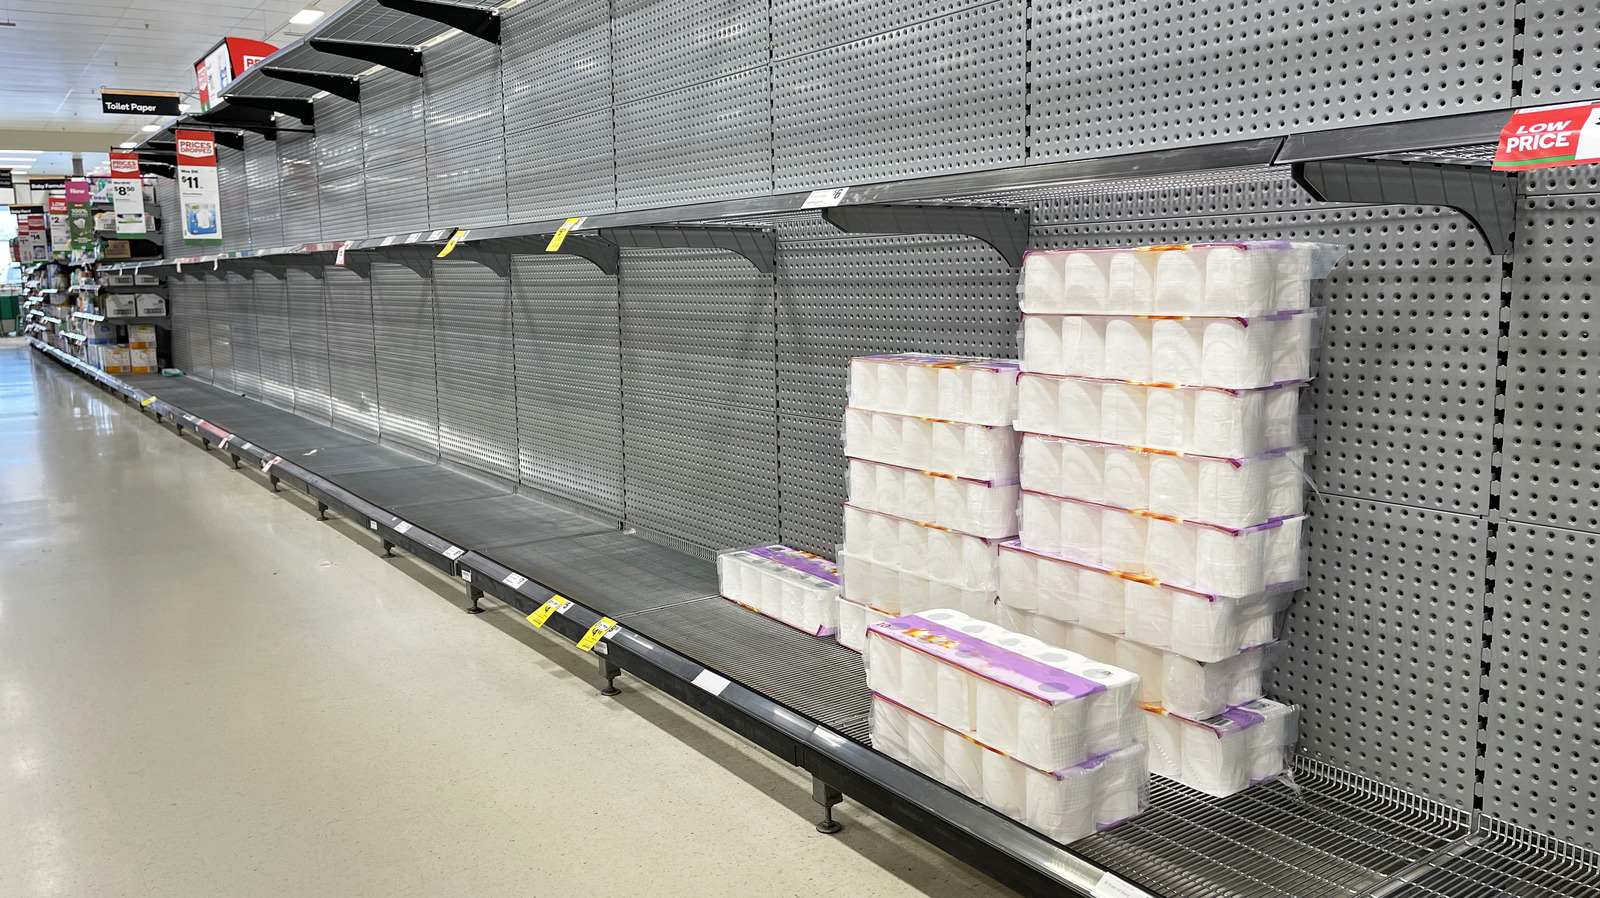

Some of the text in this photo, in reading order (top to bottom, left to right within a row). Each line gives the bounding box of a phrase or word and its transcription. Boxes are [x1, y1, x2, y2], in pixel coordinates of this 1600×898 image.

[105, 102, 157, 113] Toilet Paper
[1516, 120, 1572, 135] LOW
[180, 141, 212, 149] PRICES
[1505, 132, 1572, 153] PRICE
[181, 175, 199, 189] $11
